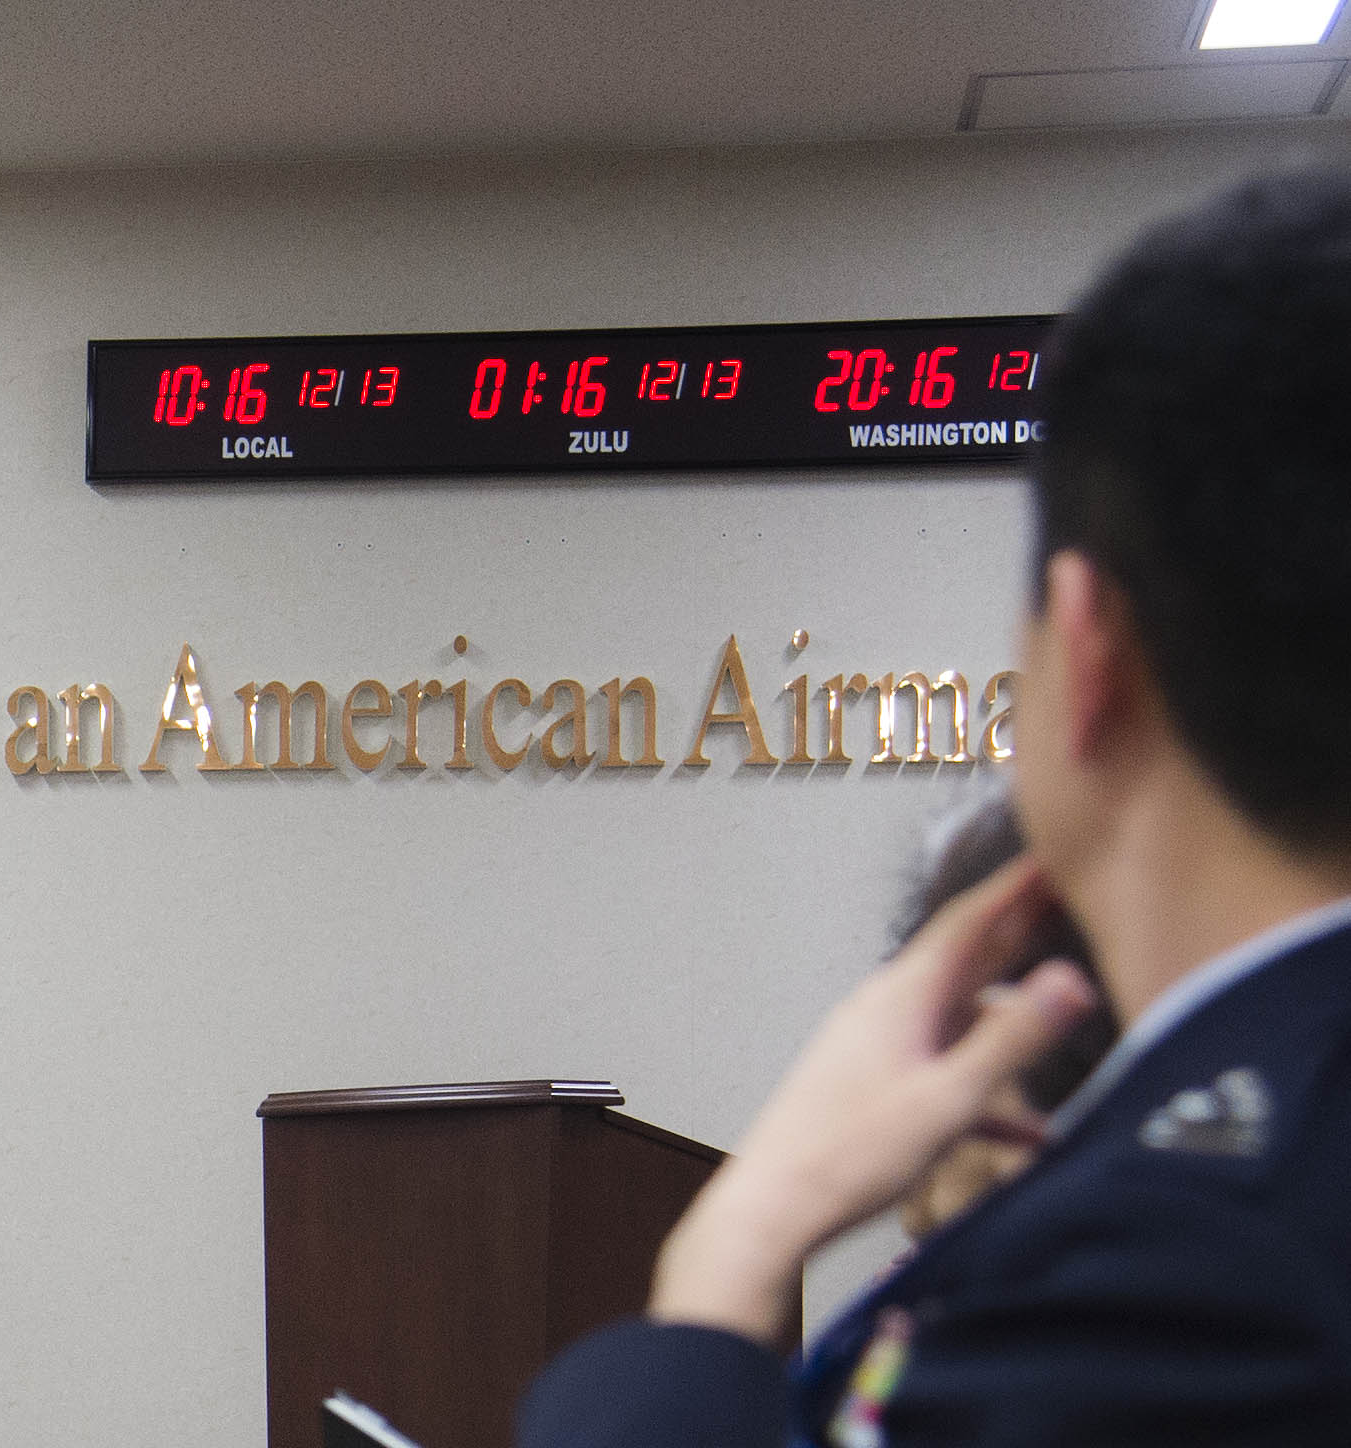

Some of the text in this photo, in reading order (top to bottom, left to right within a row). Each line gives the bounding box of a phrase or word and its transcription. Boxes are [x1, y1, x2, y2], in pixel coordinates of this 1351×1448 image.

[153, 363, 270, 427] 10:16
[469, 356, 609, 419] 01:16
[814, 346, 1040, 413] 20:16 12/
[221, 436, 293, 459] LOCAL
[568, 430, 629, 454] ZULU
[849, 421, 1007, 448] WASHINGTON
[4, 683, 124, 776] an
[138, 632, 666, 773] American
[682, 628, 1020, 767] Airma
